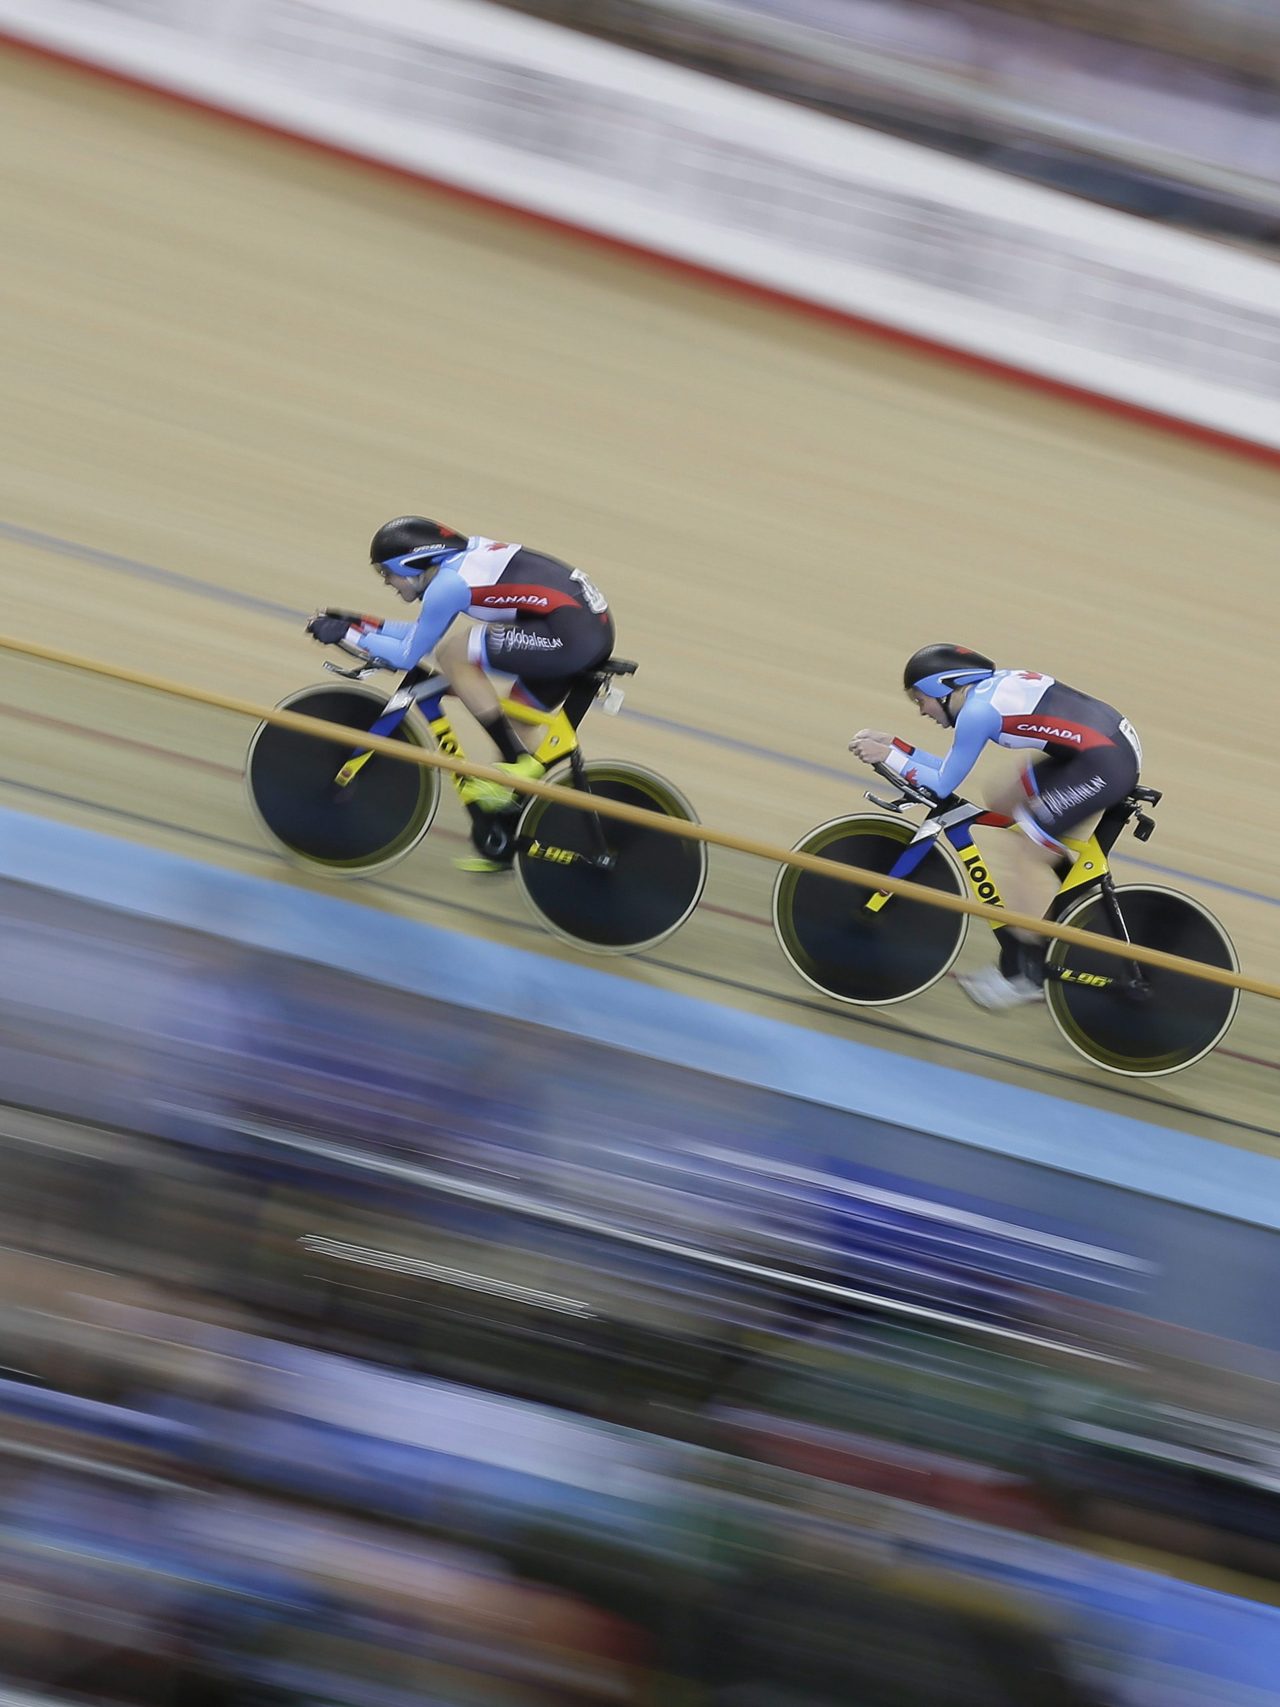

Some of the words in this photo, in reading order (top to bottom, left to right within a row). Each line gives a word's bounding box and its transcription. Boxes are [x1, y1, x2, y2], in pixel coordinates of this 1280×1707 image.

[484, 595, 548, 607] CANADA
[1017, 724, 1082, 743] CANADA
[1060, 969, 1109, 987] L96
